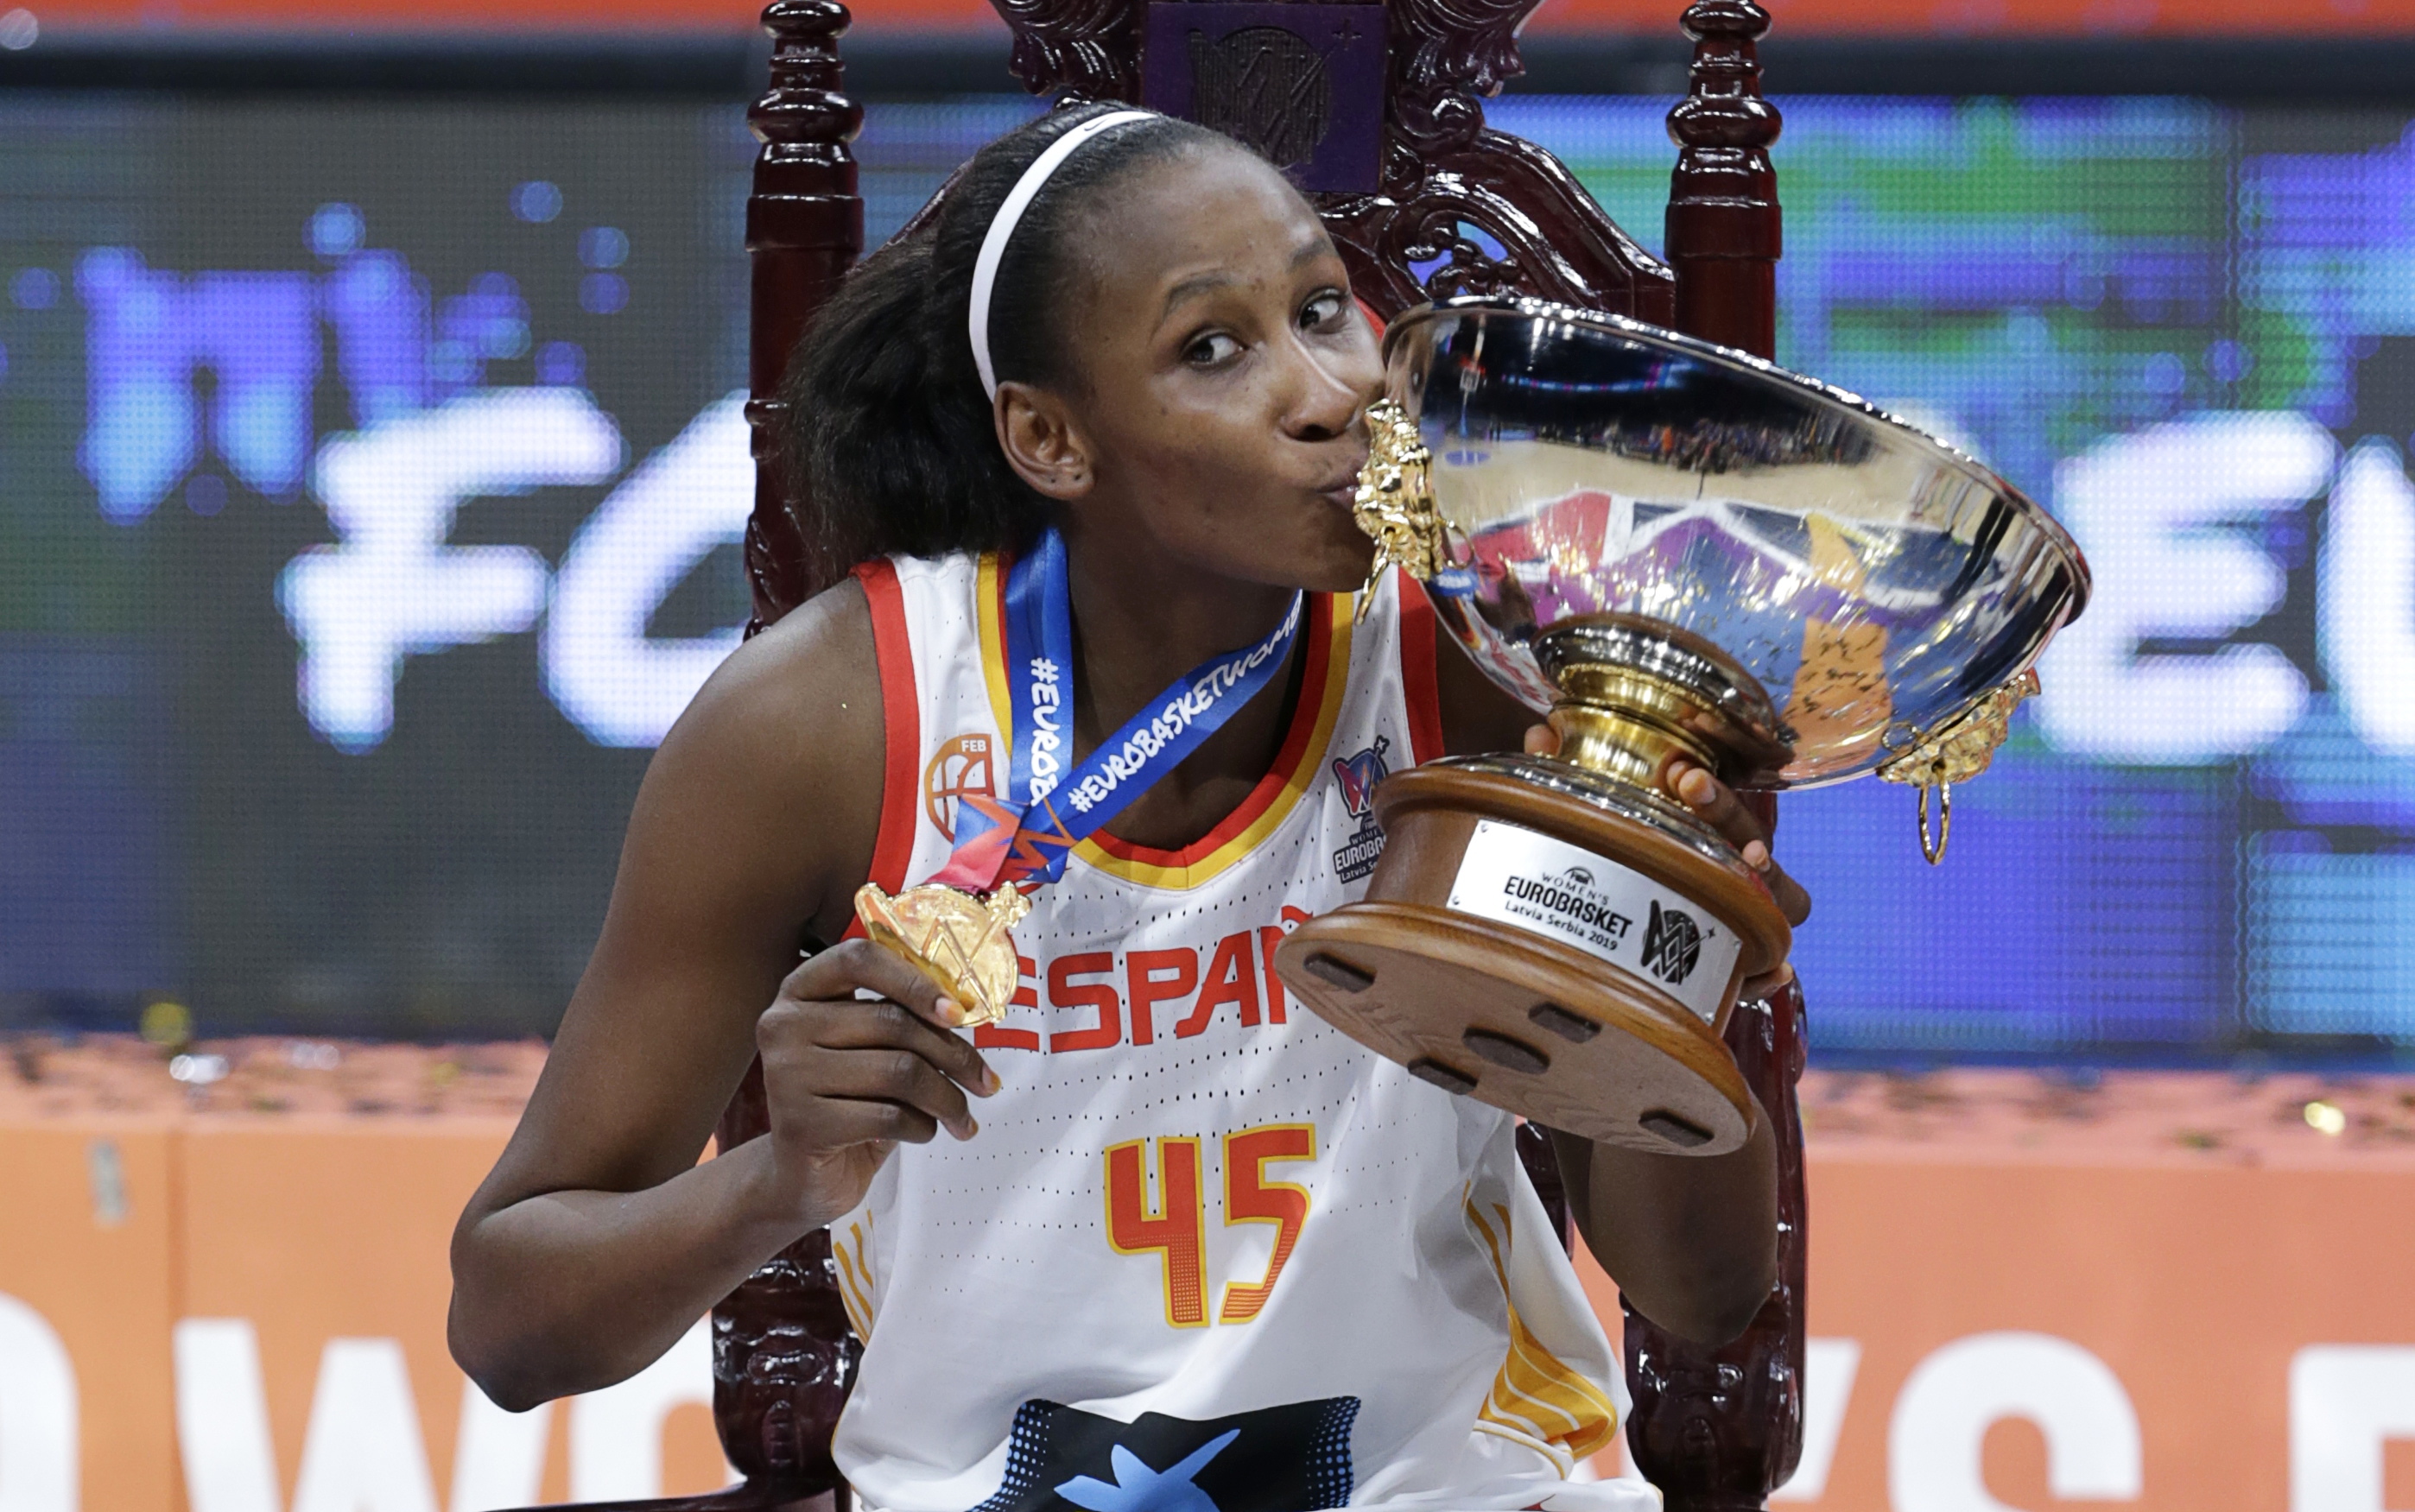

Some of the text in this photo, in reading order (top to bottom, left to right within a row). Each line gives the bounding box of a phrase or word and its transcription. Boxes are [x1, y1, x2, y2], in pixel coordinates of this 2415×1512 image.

[961, 739, 986, 752] FEB
[1341, 866, 1367, 881] Latvia
[1541, 872, 1610, 906] WOMEN'S
[1504, 875, 1633, 939] EUROBASKET
[1505, 900, 1619, 951] Latvia Serbia 2019
[1103, 1123, 1316, 1329] 45
